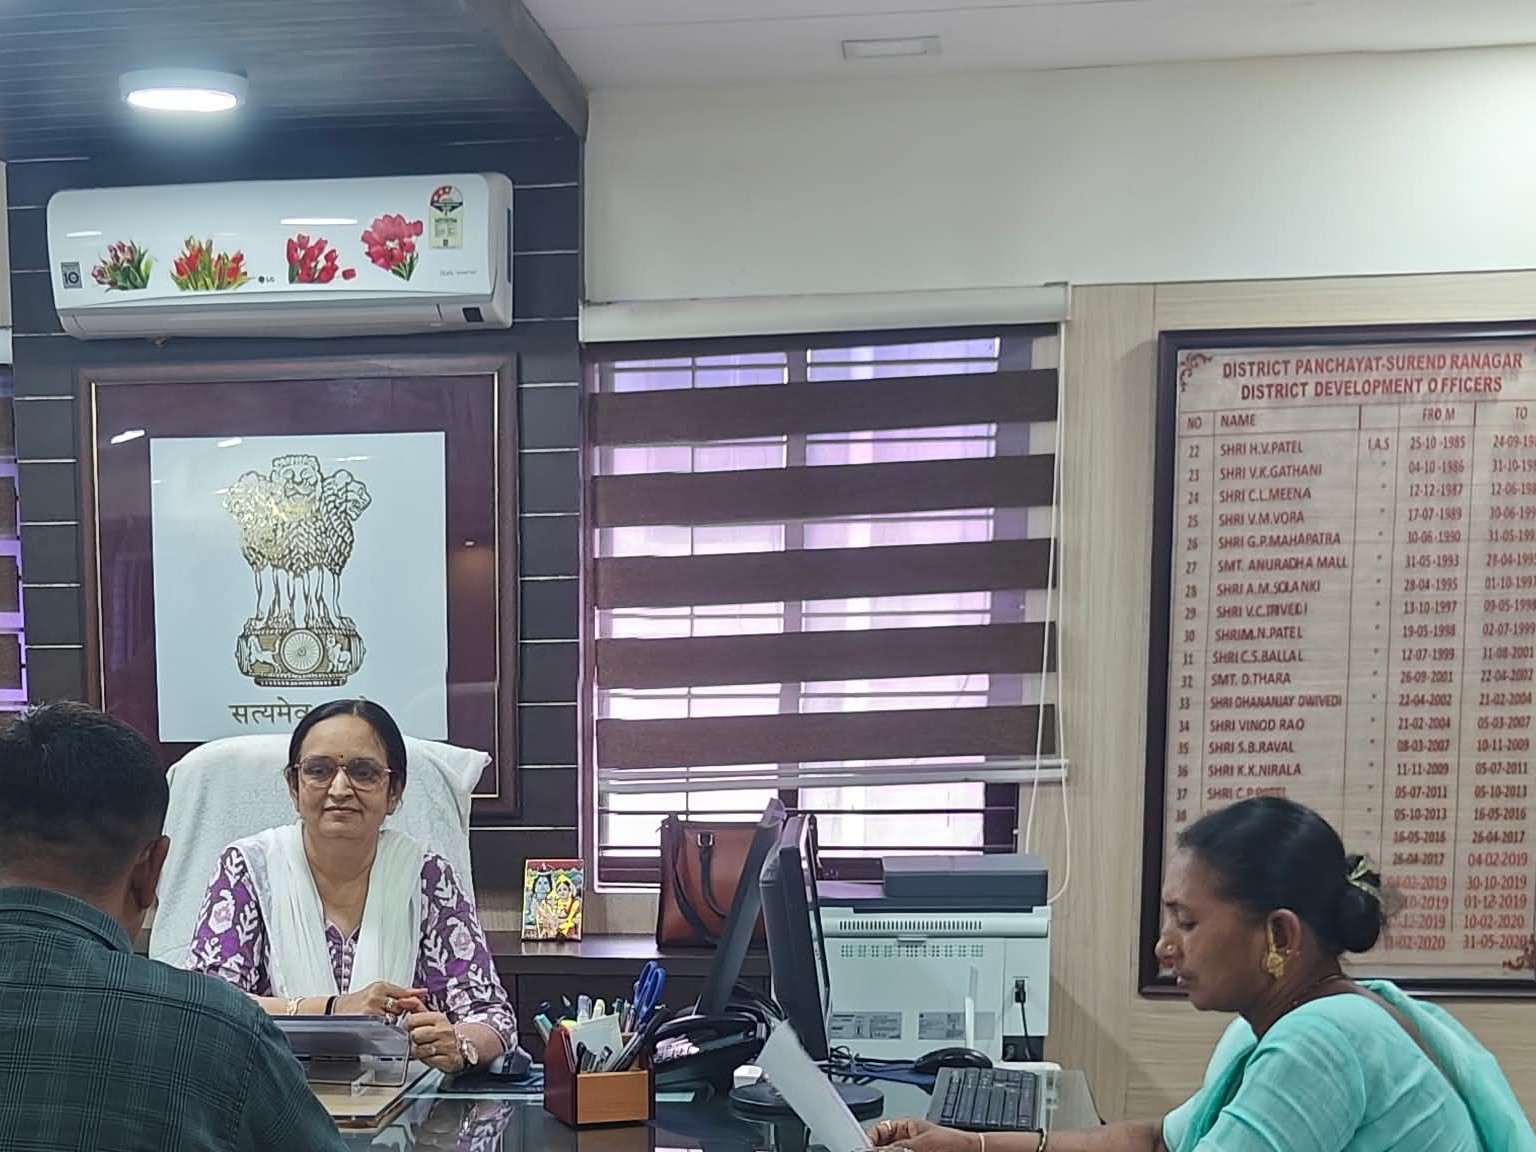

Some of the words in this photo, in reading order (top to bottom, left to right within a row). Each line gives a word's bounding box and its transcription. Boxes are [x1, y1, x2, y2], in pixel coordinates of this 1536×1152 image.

[1223, 360, 1290, 378] DISTRICT
[1241, 382, 1308, 400] DISTRICT
[1314, 378, 1423, 396] DEVELOPMENT
[1187, 417, 1202, 430] NO
[1220, 414, 1256, 428] NAME
[1515, 407, 1528, 419] TO
[1189, 445, 1199, 458] 22
[1220, 443, 1246, 456] SHRI
[1250, 440, 1303, 455] H.V.PATEL
[1189, 469, 1199, 481] 23
[1220, 467, 1245, 480] SHRI
[1249, 464, 1322, 478] V.K.GATHANI
[1188, 492, 1199, 504] 24
[1219, 490, 1245, 503] SHRI
[1248, 487, 1311, 502] C.L.MEENA
[1219, 514, 1244, 527] SHRI
[1248, 511, 1305, 525] V.M.VORA
[1218, 536, 1244, 549] SHRI
[1248, 532, 1341, 548] G.P.MAHAPATRA
[1186, 561, 1197, 574] 27
[1218, 560, 1244, 573] SMT.
[1316, 556, 1348, 568] MALL
[1185, 585, 1197, 598] 28
[1216, 583, 1243, 597] SHRI
[1185, 608, 1196, 620] 29
[1216, 606, 1242, 618] SHRI
[1184, 630, 1195, 642] 30
[1212, 652, 1238, 664] SHRI
[1181, 675, 1193, 688] 32
[1211, 674, 1238, 686] SMT.
[1242, 672, 1291, 685] D.THARA
[1179, 697, 1190, 710] 33
[1210, 696, 1233, 709] SHRI
[1179, 720, 1190, 732] 34
[1210, 719, 1235, 732] SHRI
[1239, 719, 1276, 731] VINOD
[1279, 718, 1305, 730] RAO
[1178, 742, 1189, 754] 35
[1209, 742, 1234, 754] SHRI
[1238, 741, 1295, 753] S.B.RAVAL
[1177, 765, 1188, 777] 36
[1208, 765, 1234, 777] SHRI
[1176, 788, 1187, 800] 37
[1207, 788, 1233, 800] SHRI
